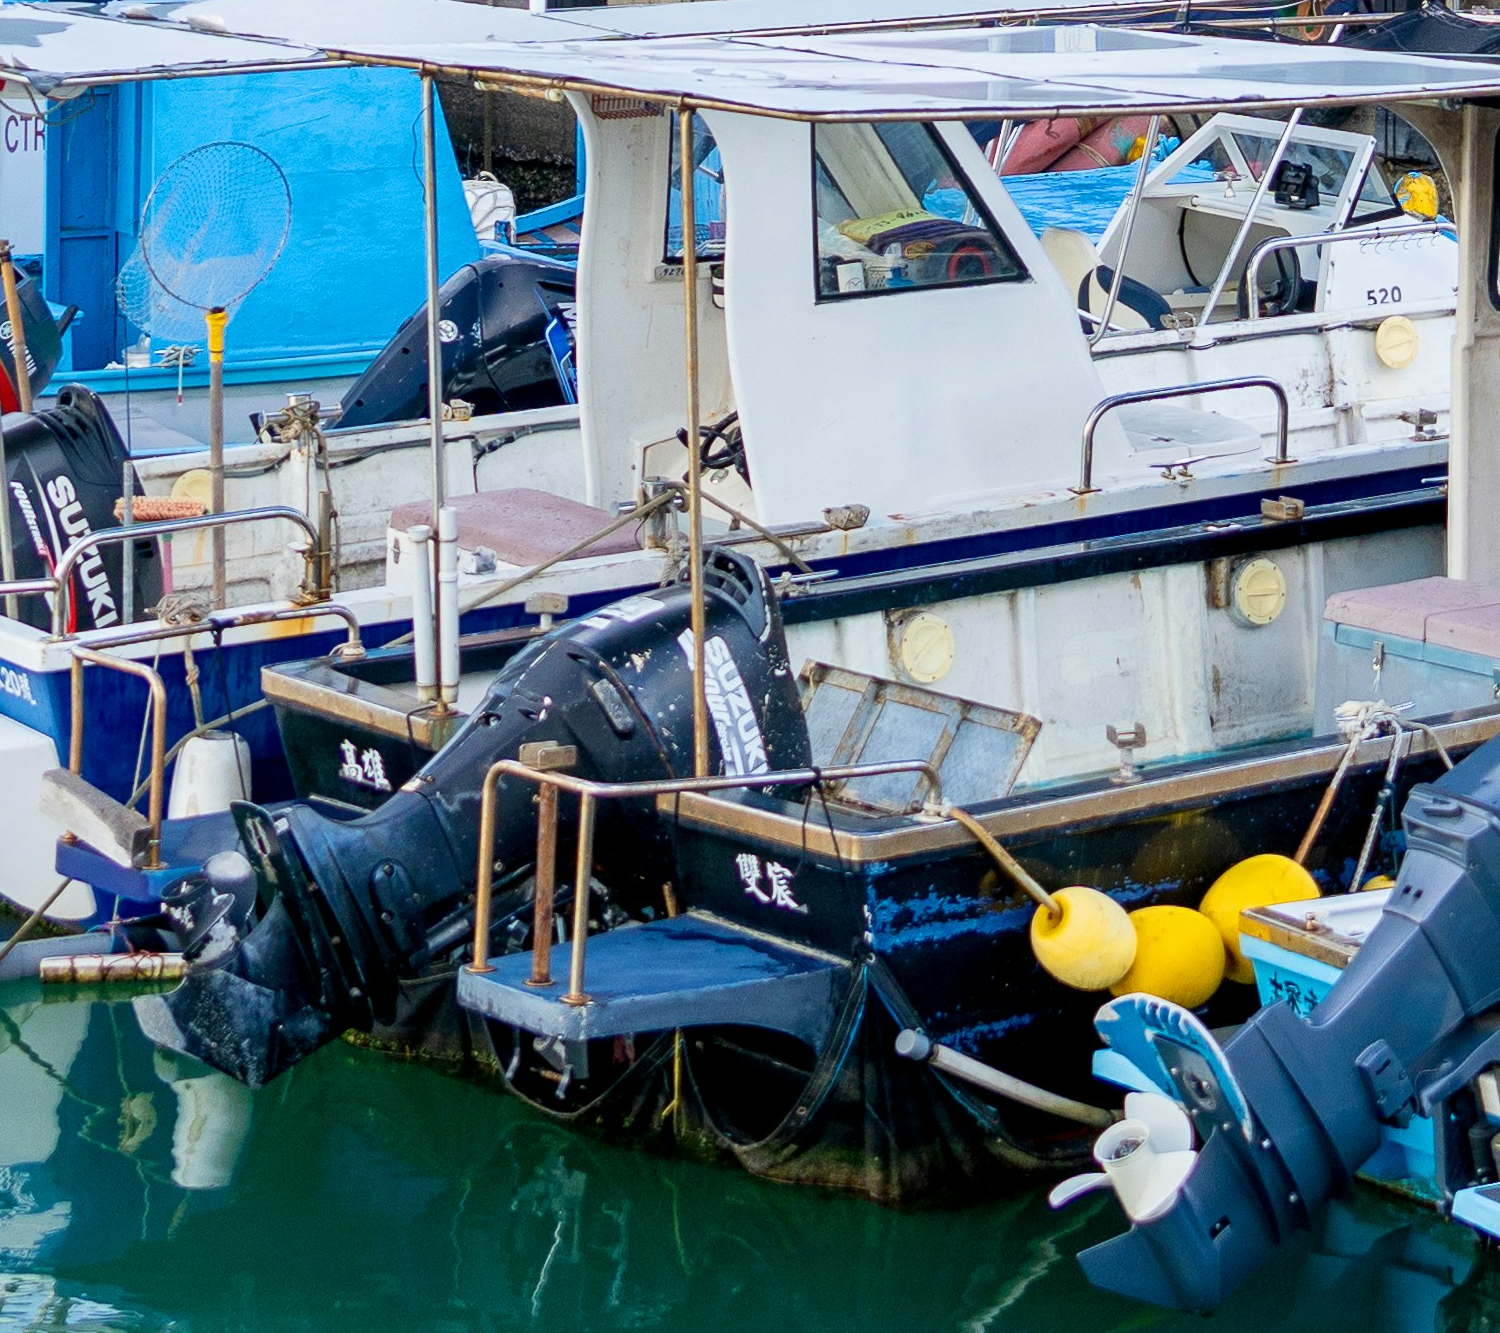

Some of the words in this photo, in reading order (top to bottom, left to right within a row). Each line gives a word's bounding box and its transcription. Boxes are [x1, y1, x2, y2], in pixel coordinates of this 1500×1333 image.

[4, 114, 46, 153] CTR
[1366, 285, 1402, 306] 520
[47, 475, 119, 630] SUZUKI
[703, 635, 770, 777] SUZUKI
[340, 738, 390, 790] 高雄
